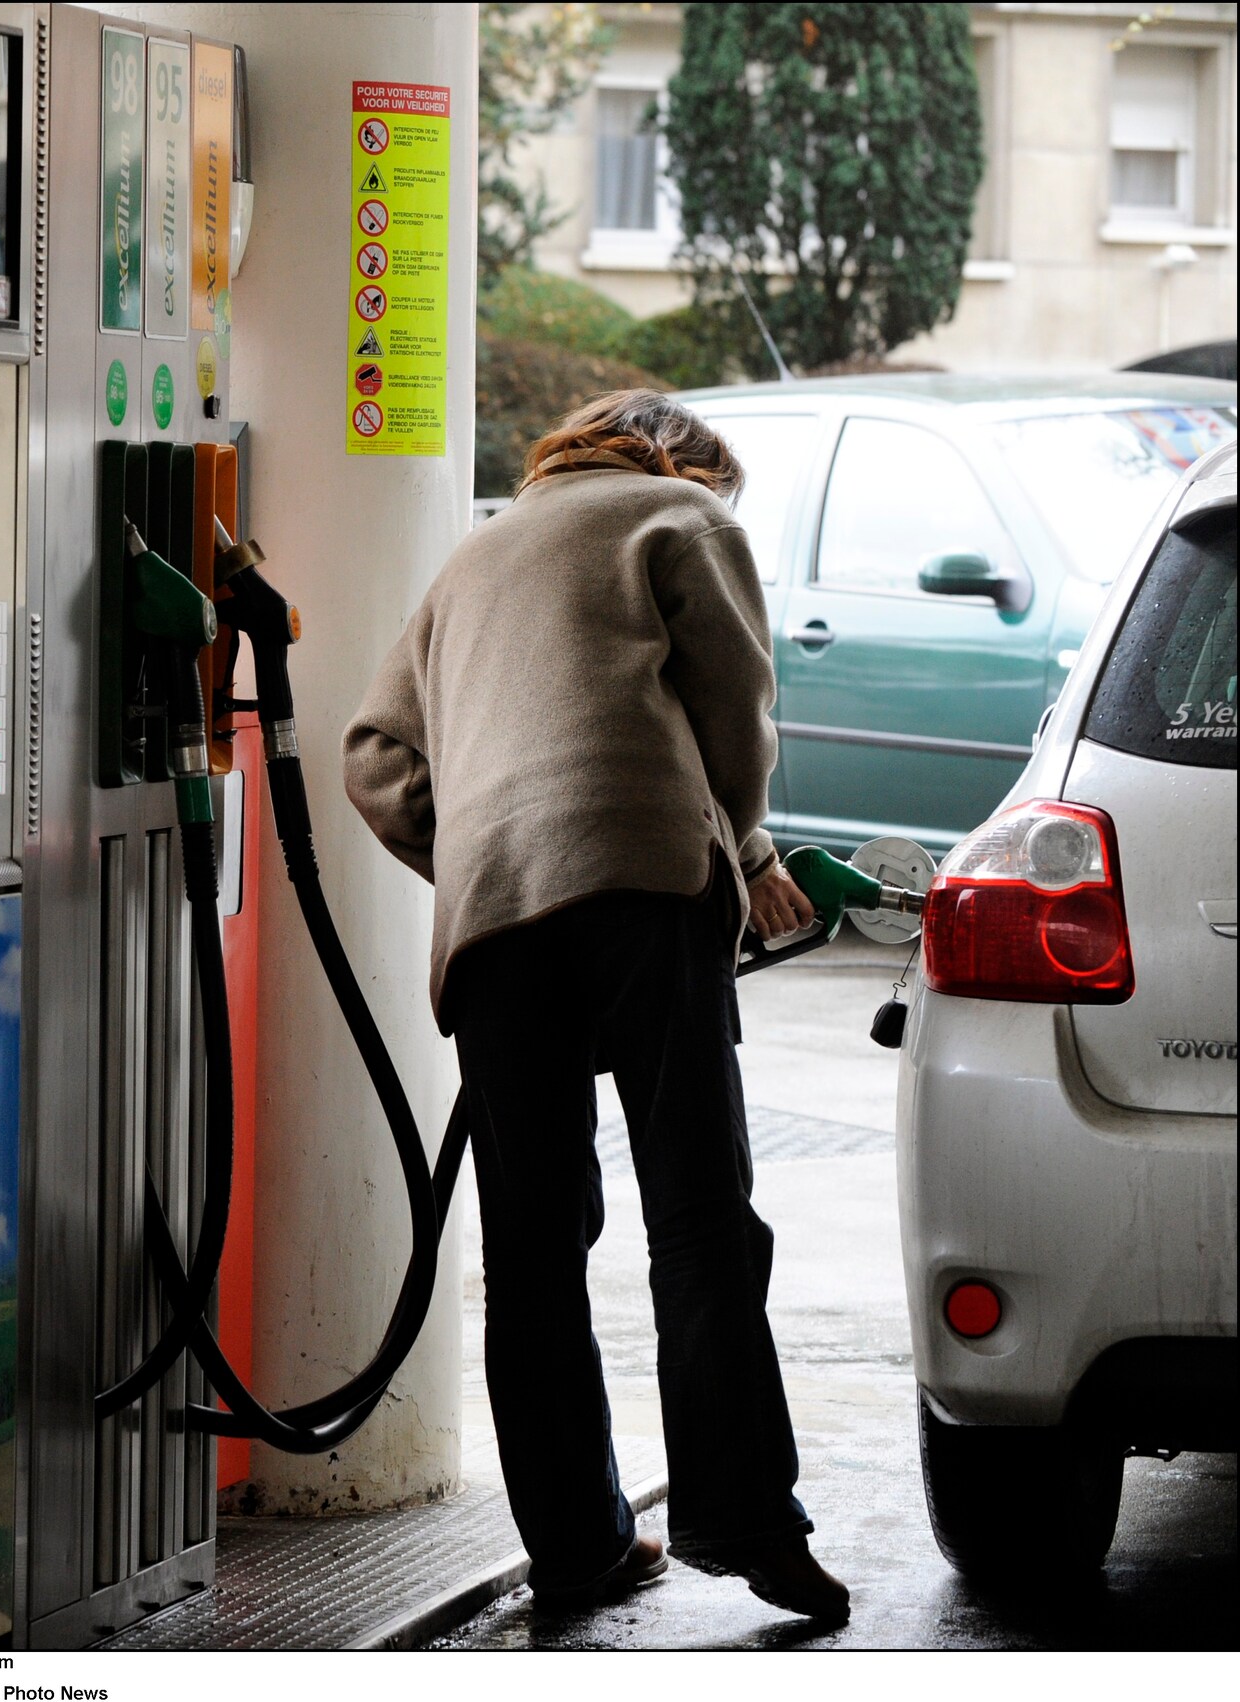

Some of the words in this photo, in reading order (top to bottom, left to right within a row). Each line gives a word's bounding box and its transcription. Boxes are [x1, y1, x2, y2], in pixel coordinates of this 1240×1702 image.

[111, 51, 137, 115] 98
[156, 62, 182, 124] 95
[198, 68, 227, 98] diesel
[357, 86, 385, 97] POUR
[387, 88, 413, 99] VOTRE
[415, 89, 449, 102] SECURITE
[362, 98, 390, 108] VOOR
[392, 100, 405, 109] UW
[406, 101, 445, 113] VEILIGHEID
[119, 130, 130, 311] excellium
[163, 140, 176, 316] excellium
[205, 140, 218, 314] excellium
[1170, 702, 1193, 725] 5
[1204, 701, 1238, 724] Ye
